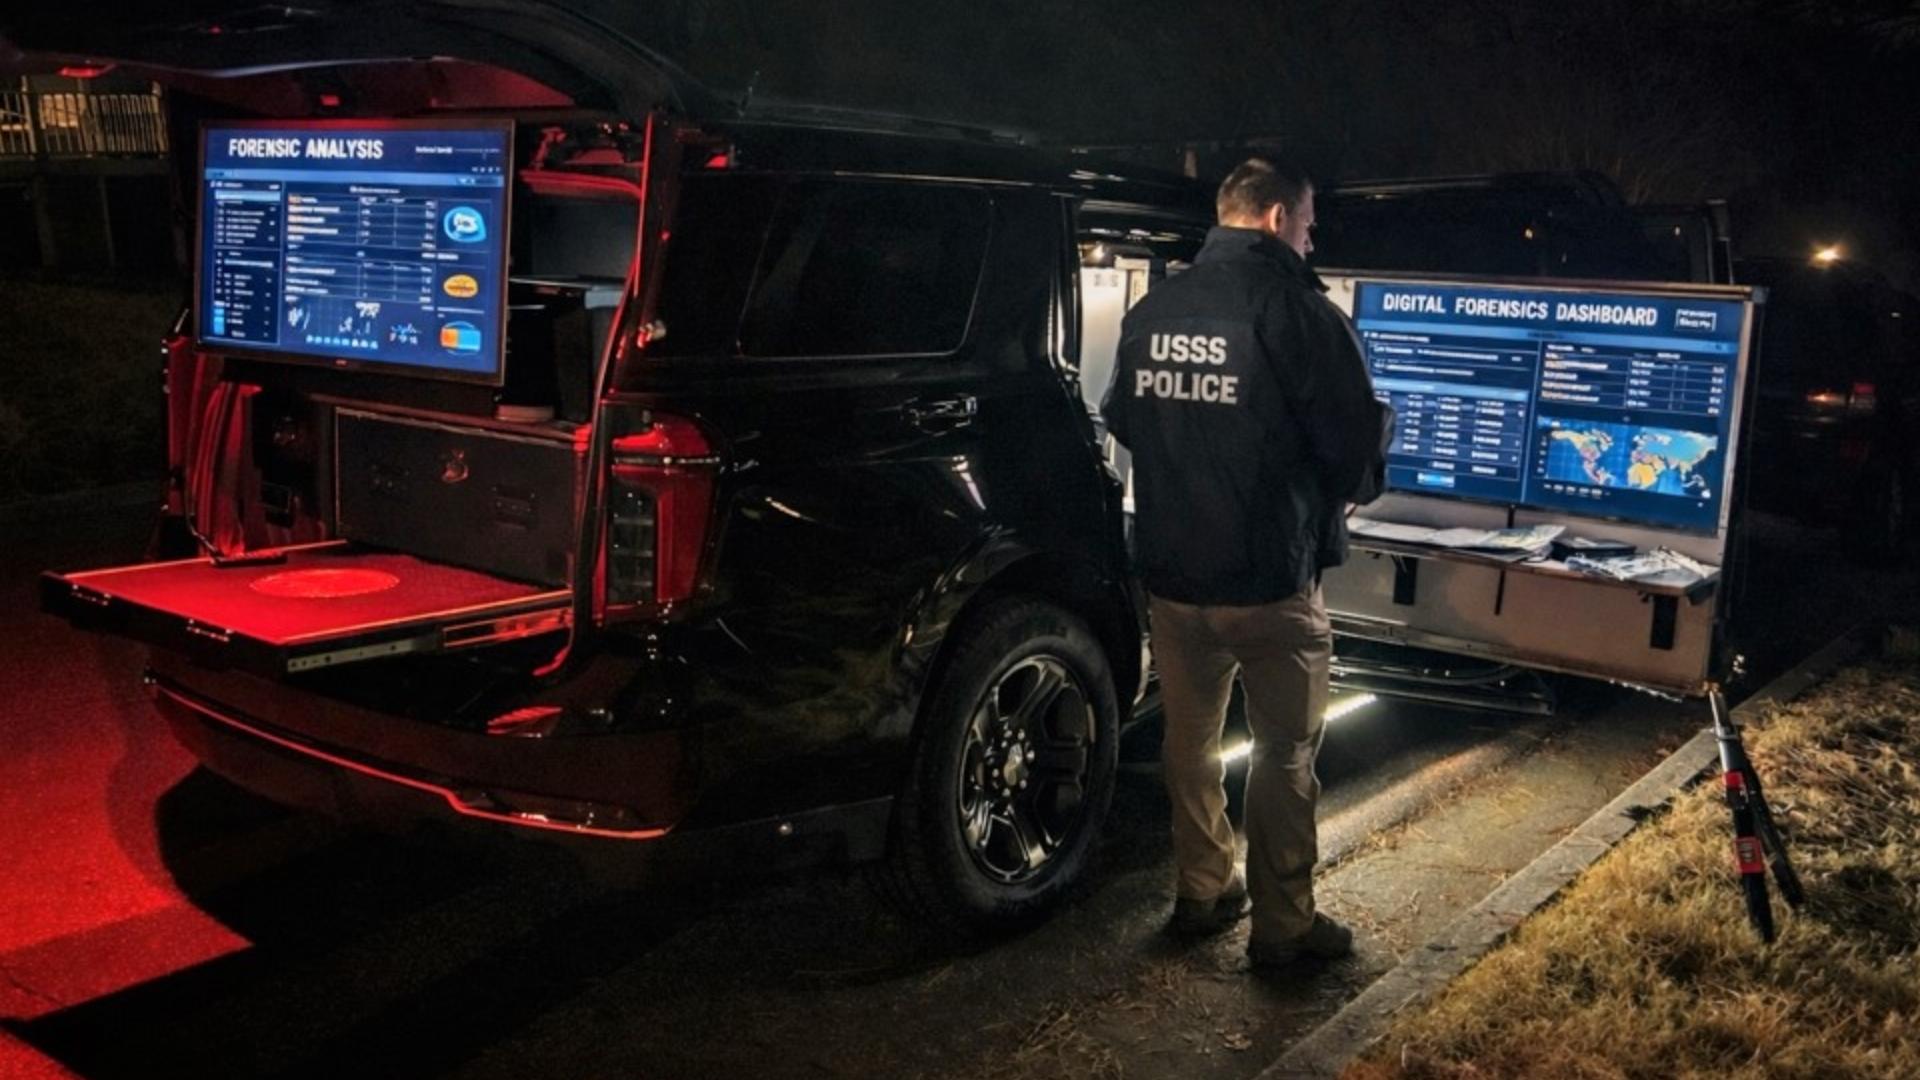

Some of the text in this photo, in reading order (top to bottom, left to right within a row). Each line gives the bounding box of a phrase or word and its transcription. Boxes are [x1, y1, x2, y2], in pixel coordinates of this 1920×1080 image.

[229, 138, 383, 159] FORENSIC ANALYSIS
[1383, 293, 1446, 314] DIGITAL
[1455, 297, 1548, 319] FORENSICS
[1556, 303, 1657, 326] DASHBOARD
[1150, 334, 1227, 365] USSS
[1135, 369, 1239, 404] POLICE
